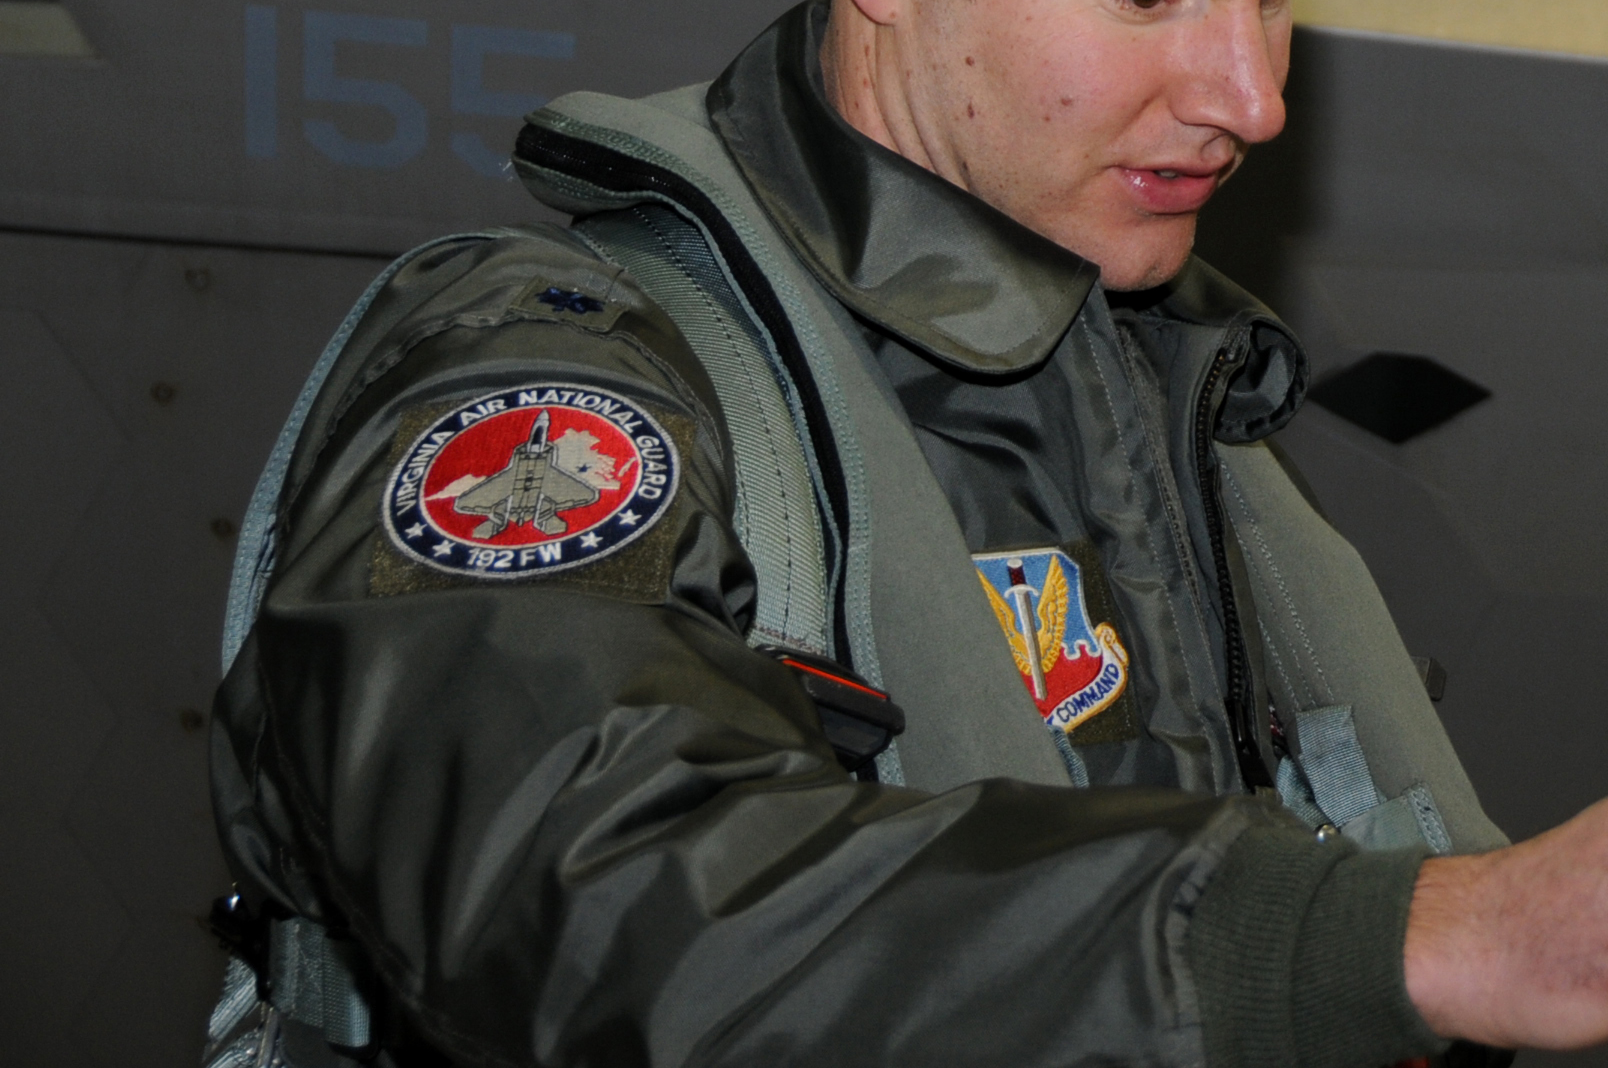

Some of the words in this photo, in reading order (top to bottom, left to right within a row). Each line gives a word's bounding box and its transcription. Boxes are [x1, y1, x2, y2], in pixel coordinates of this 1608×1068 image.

[244, 5, 576, 179] 155
[397, 431, 454, 516] VIRGINIA
[460, 399, 507, 426] AIR
[519, 390, 642, 433] NATIONAL
[636, 436, 666, 499] GUARD
[468, 549, 514, 568] 192
[520, 543, 562, 565] FW
[1056, 663, 1119, 723] COMMAND
